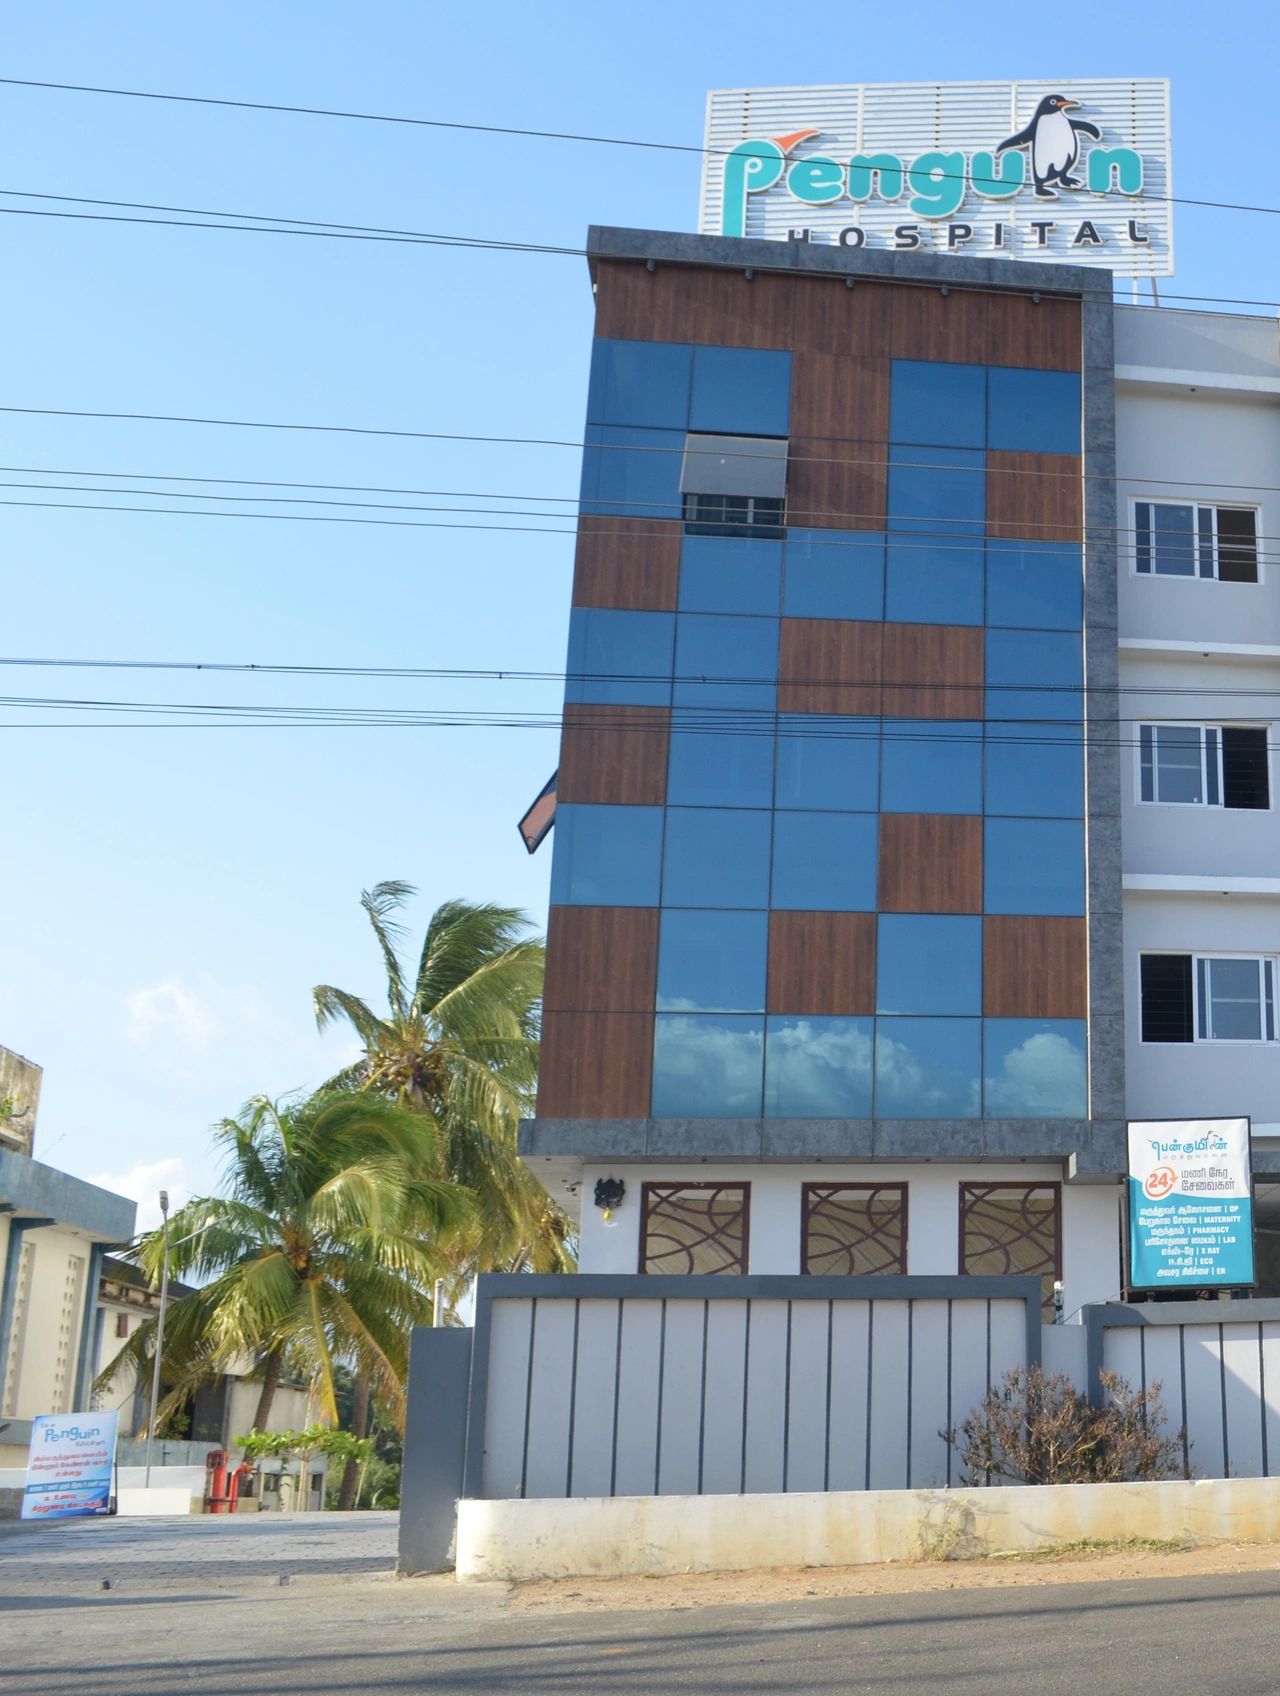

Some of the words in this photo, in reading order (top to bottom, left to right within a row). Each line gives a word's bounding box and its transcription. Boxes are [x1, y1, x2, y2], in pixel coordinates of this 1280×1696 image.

[787, 219, 1150, 249] HOSPITAL
[1148, 1172, 1168, 1188] 24
[1181, 1168, 1206, 1178] மணி
[1209, 1167, 1228, 1178] நேர
[1181, 1177, 1235, 1191] சேவைகள்
[44, 1426, 100, 1443] Penguin
